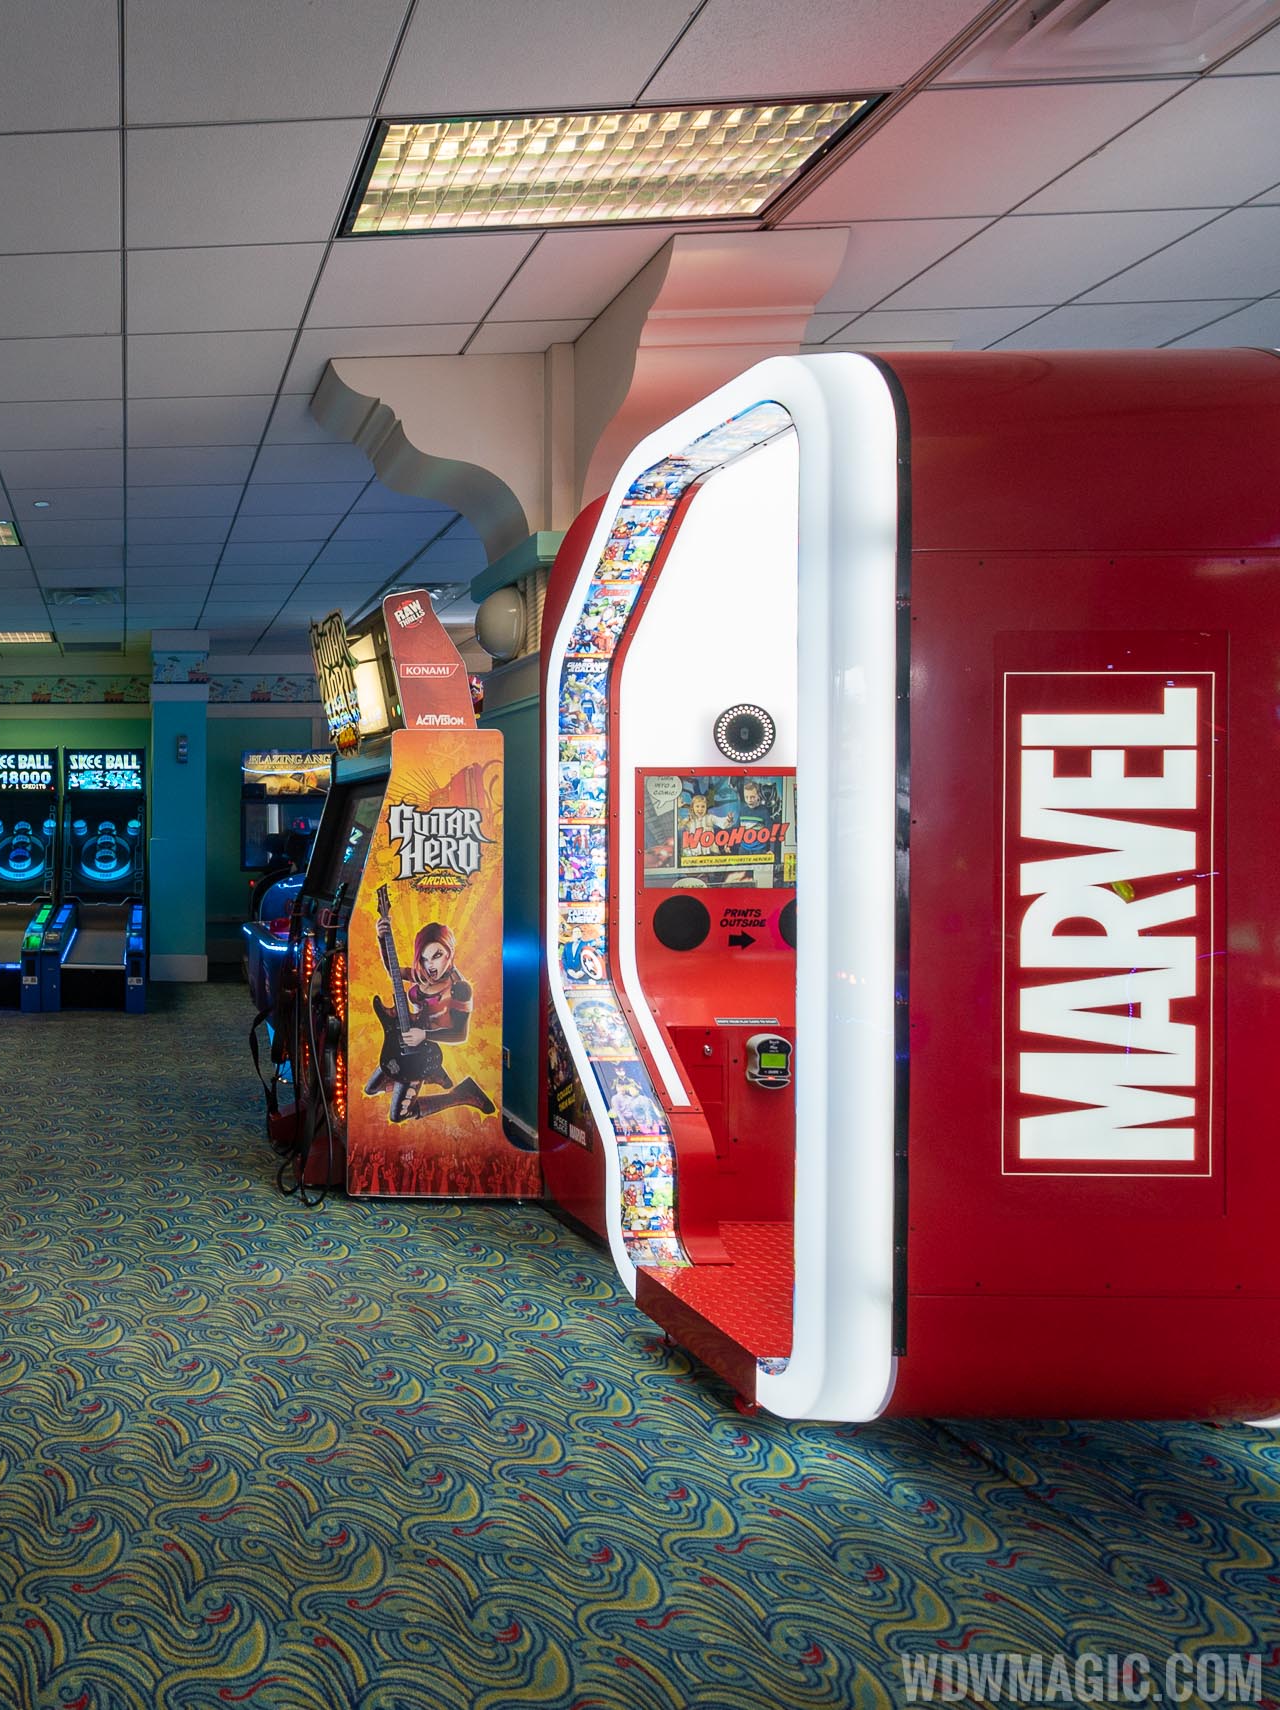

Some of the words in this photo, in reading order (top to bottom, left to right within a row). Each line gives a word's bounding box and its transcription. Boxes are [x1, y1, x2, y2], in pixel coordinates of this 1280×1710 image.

[394, 600, 422, 620] RAW
[399, 609, 426, 628] THRILLS
[405, 666, 450, 675] KONAMI
[416, 713, 464, 726] ACTIVISION
[18, 754, 52, 769] BALL
[70, 754, 103, 769] SKEE
[105, 754, 140, 769] BALL
[248, 754, 303, 764] BLAZING
[0, 771, 51, 785] 18000
[387, 801, 496, 851] GUITAR
[682, 823, 790, 849] WOOHOO!!
[393, 832, 483, 881] HERO
[417, 876, 462, 886] ARCADE
[723, 908, 762, 917] PRINTS
[720, 918, 767, 927] OUTSIDE
[1020, 687, 1198, 1161] MARVEL
